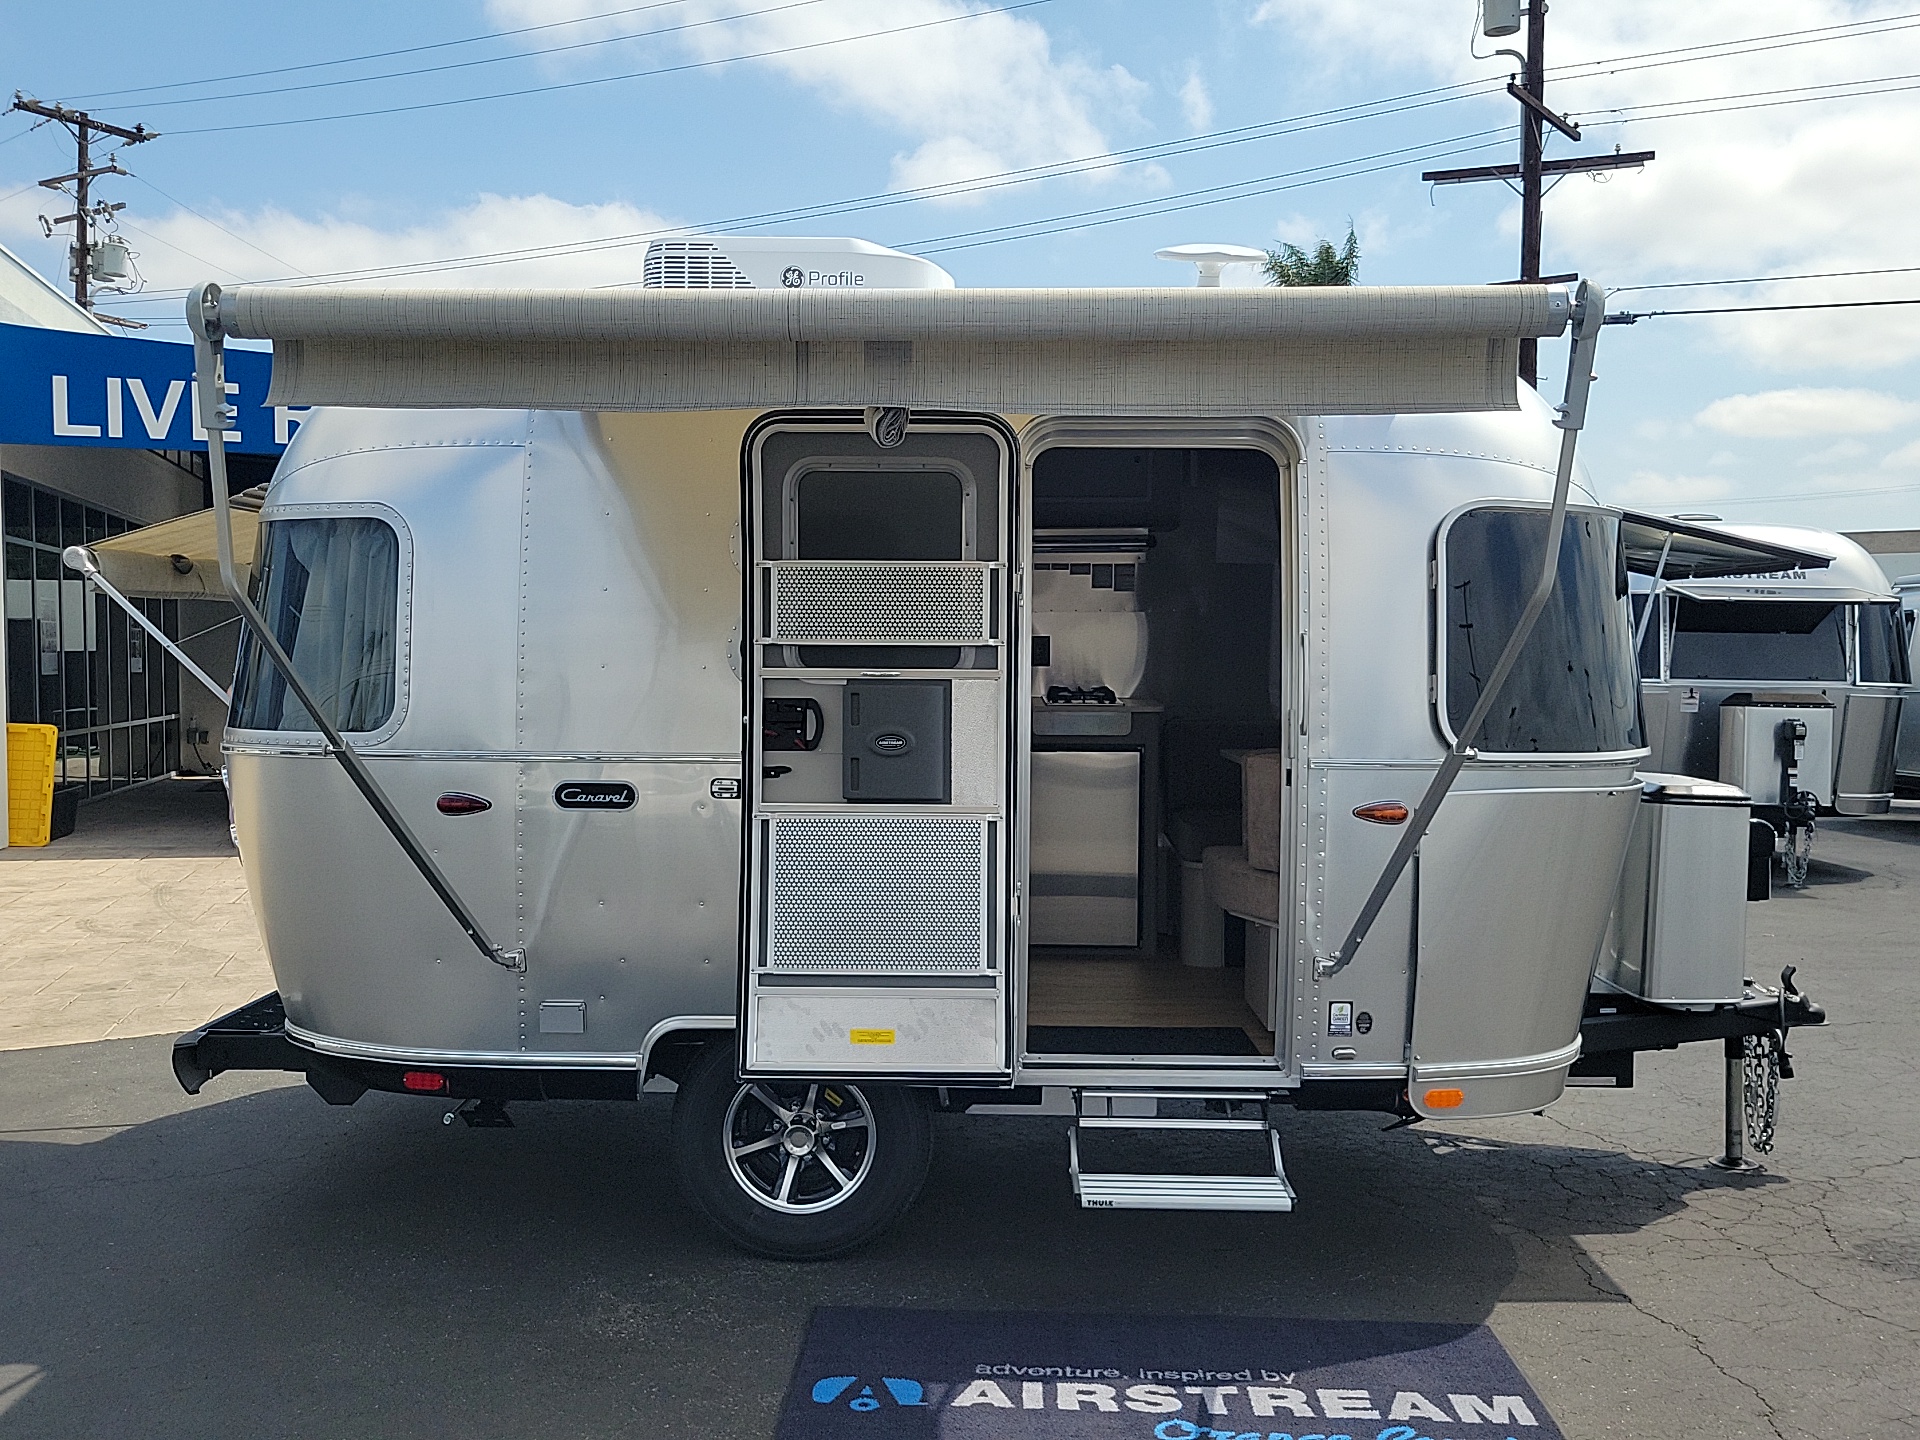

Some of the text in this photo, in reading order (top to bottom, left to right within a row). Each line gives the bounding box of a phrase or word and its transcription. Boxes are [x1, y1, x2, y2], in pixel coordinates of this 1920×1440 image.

[808, 271, 864, 286] Profile
[52, 375, 242, 443] LIVE
[561, 788, 630, 803] Caravel
[1139, 1367, 1253, 1382] inspired
[1260, 1369, 1297, 1385] by
[953, 1380, 1539, 1426] AIRSTREAM
